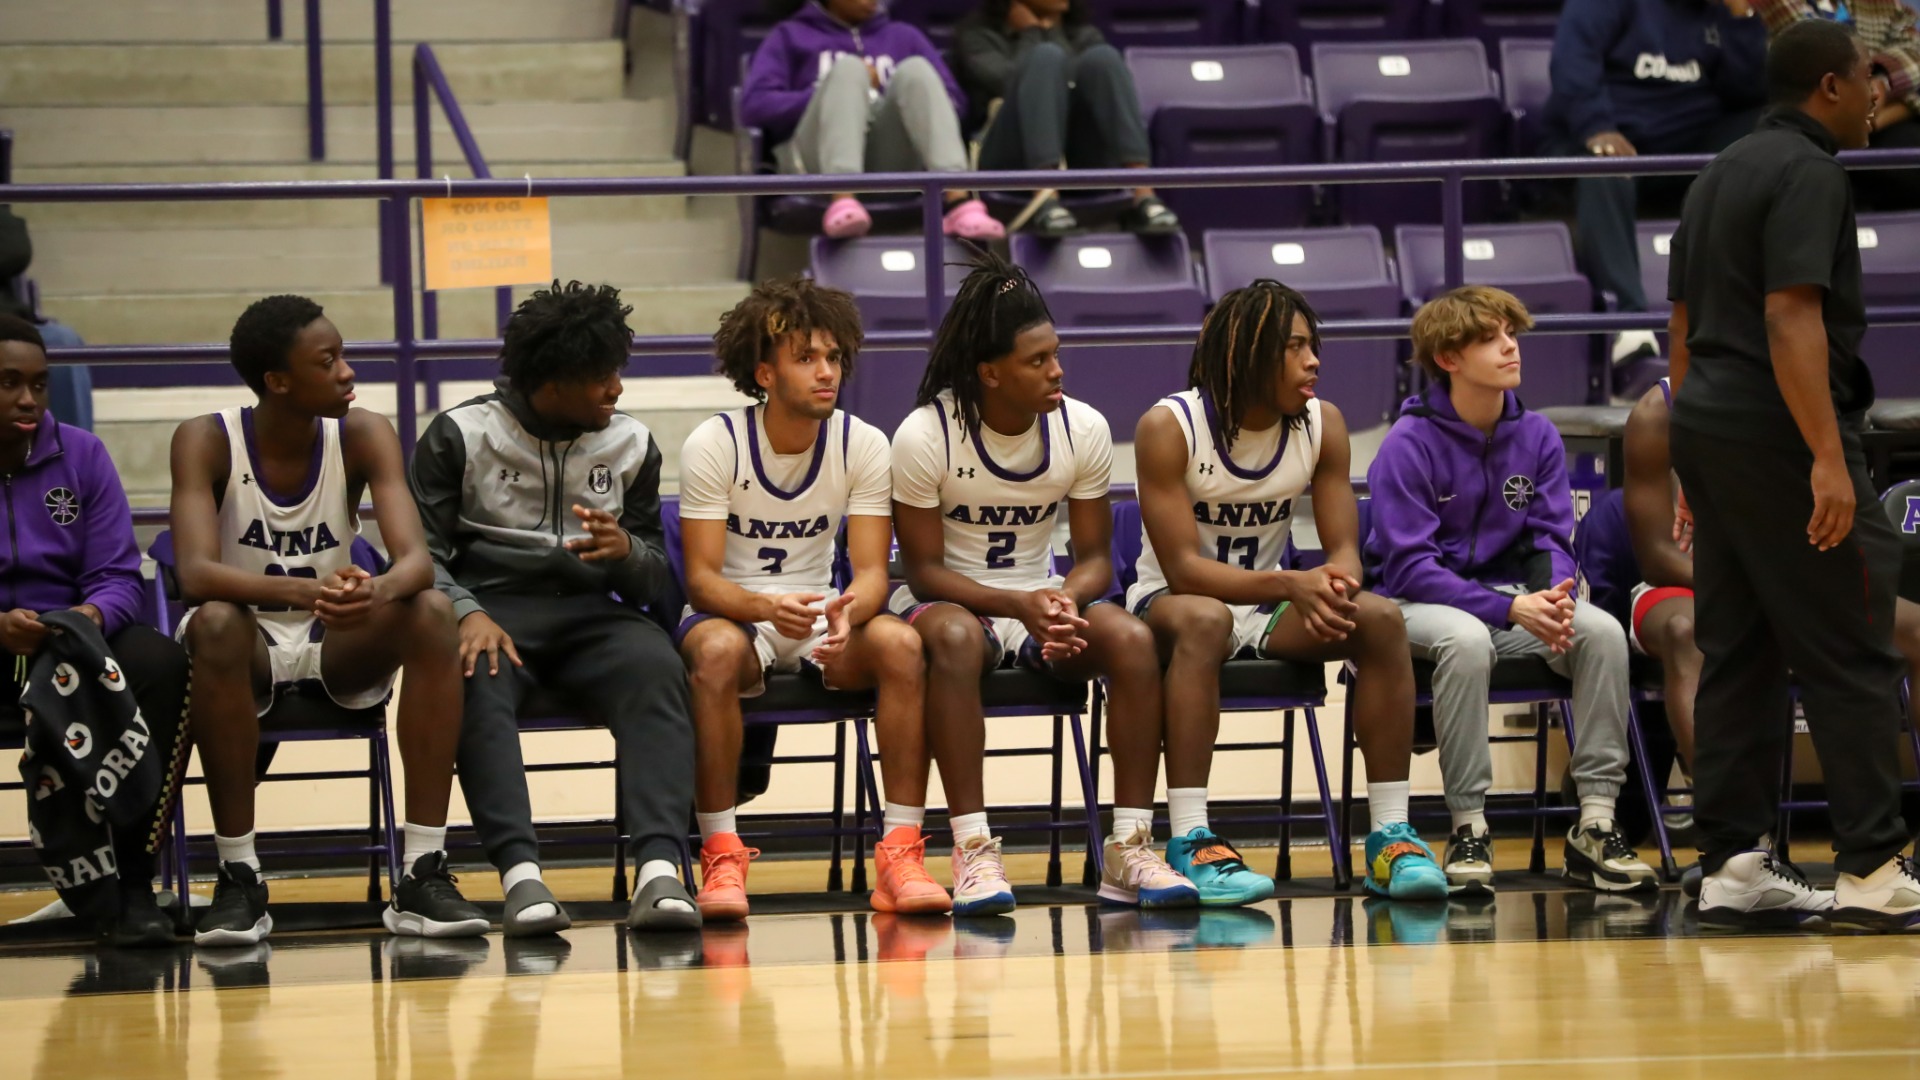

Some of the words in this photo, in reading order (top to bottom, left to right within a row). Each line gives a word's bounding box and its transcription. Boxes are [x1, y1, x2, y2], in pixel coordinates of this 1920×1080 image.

[726, 512, 829, 538] ANNA
[945, 501, 1058, 525] ANNA
[1193, 498, 1292, 527] ANNA
[986, 531, 1017, 569] 2
[1216, 535, 1259, 570] 13
